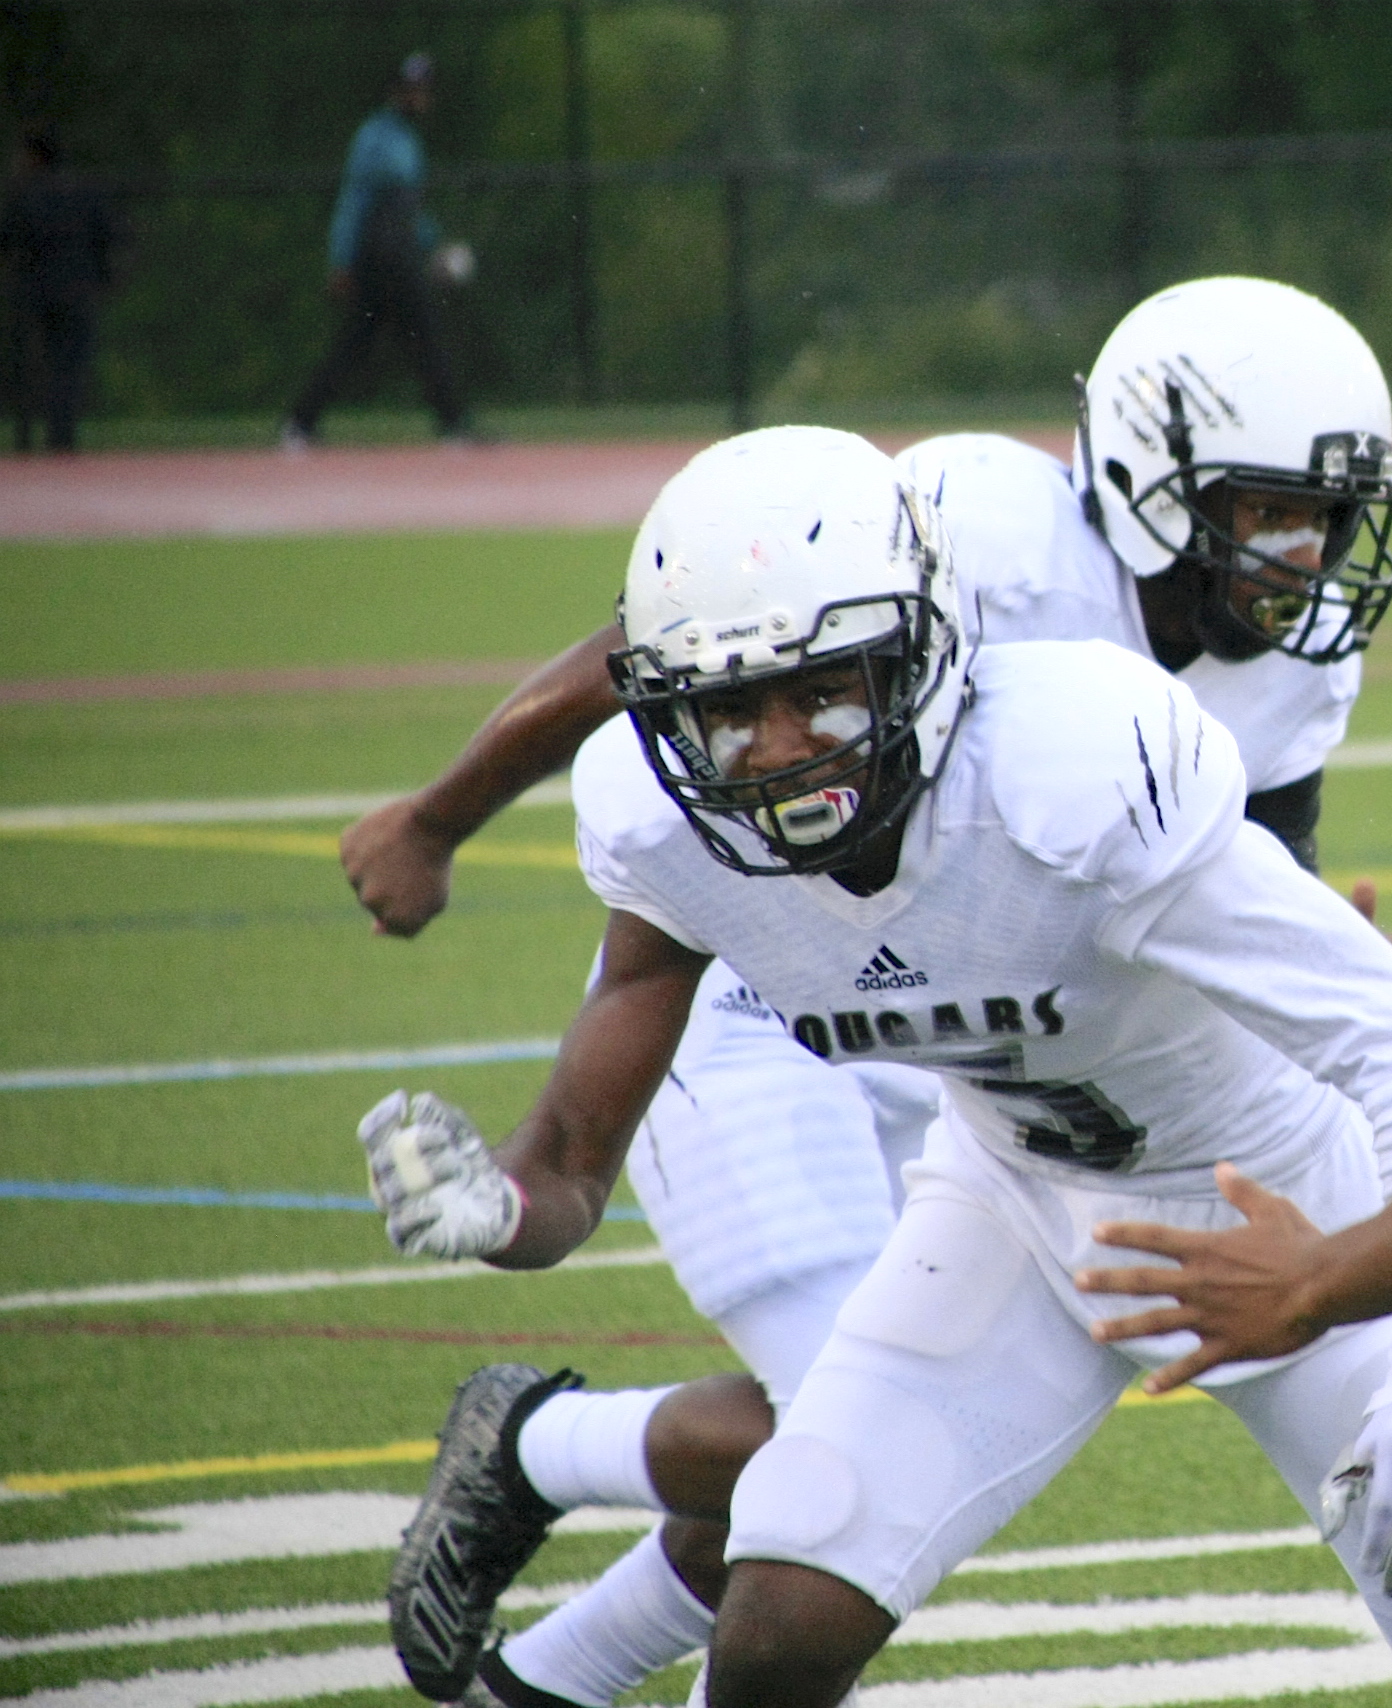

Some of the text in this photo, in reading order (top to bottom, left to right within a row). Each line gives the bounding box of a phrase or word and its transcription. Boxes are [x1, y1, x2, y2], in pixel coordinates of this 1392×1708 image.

[854, 970, 929, 992] adidas
[711, 999, 770, 1020] adidas
[774, 983, 1065, 1060] OUGARS
